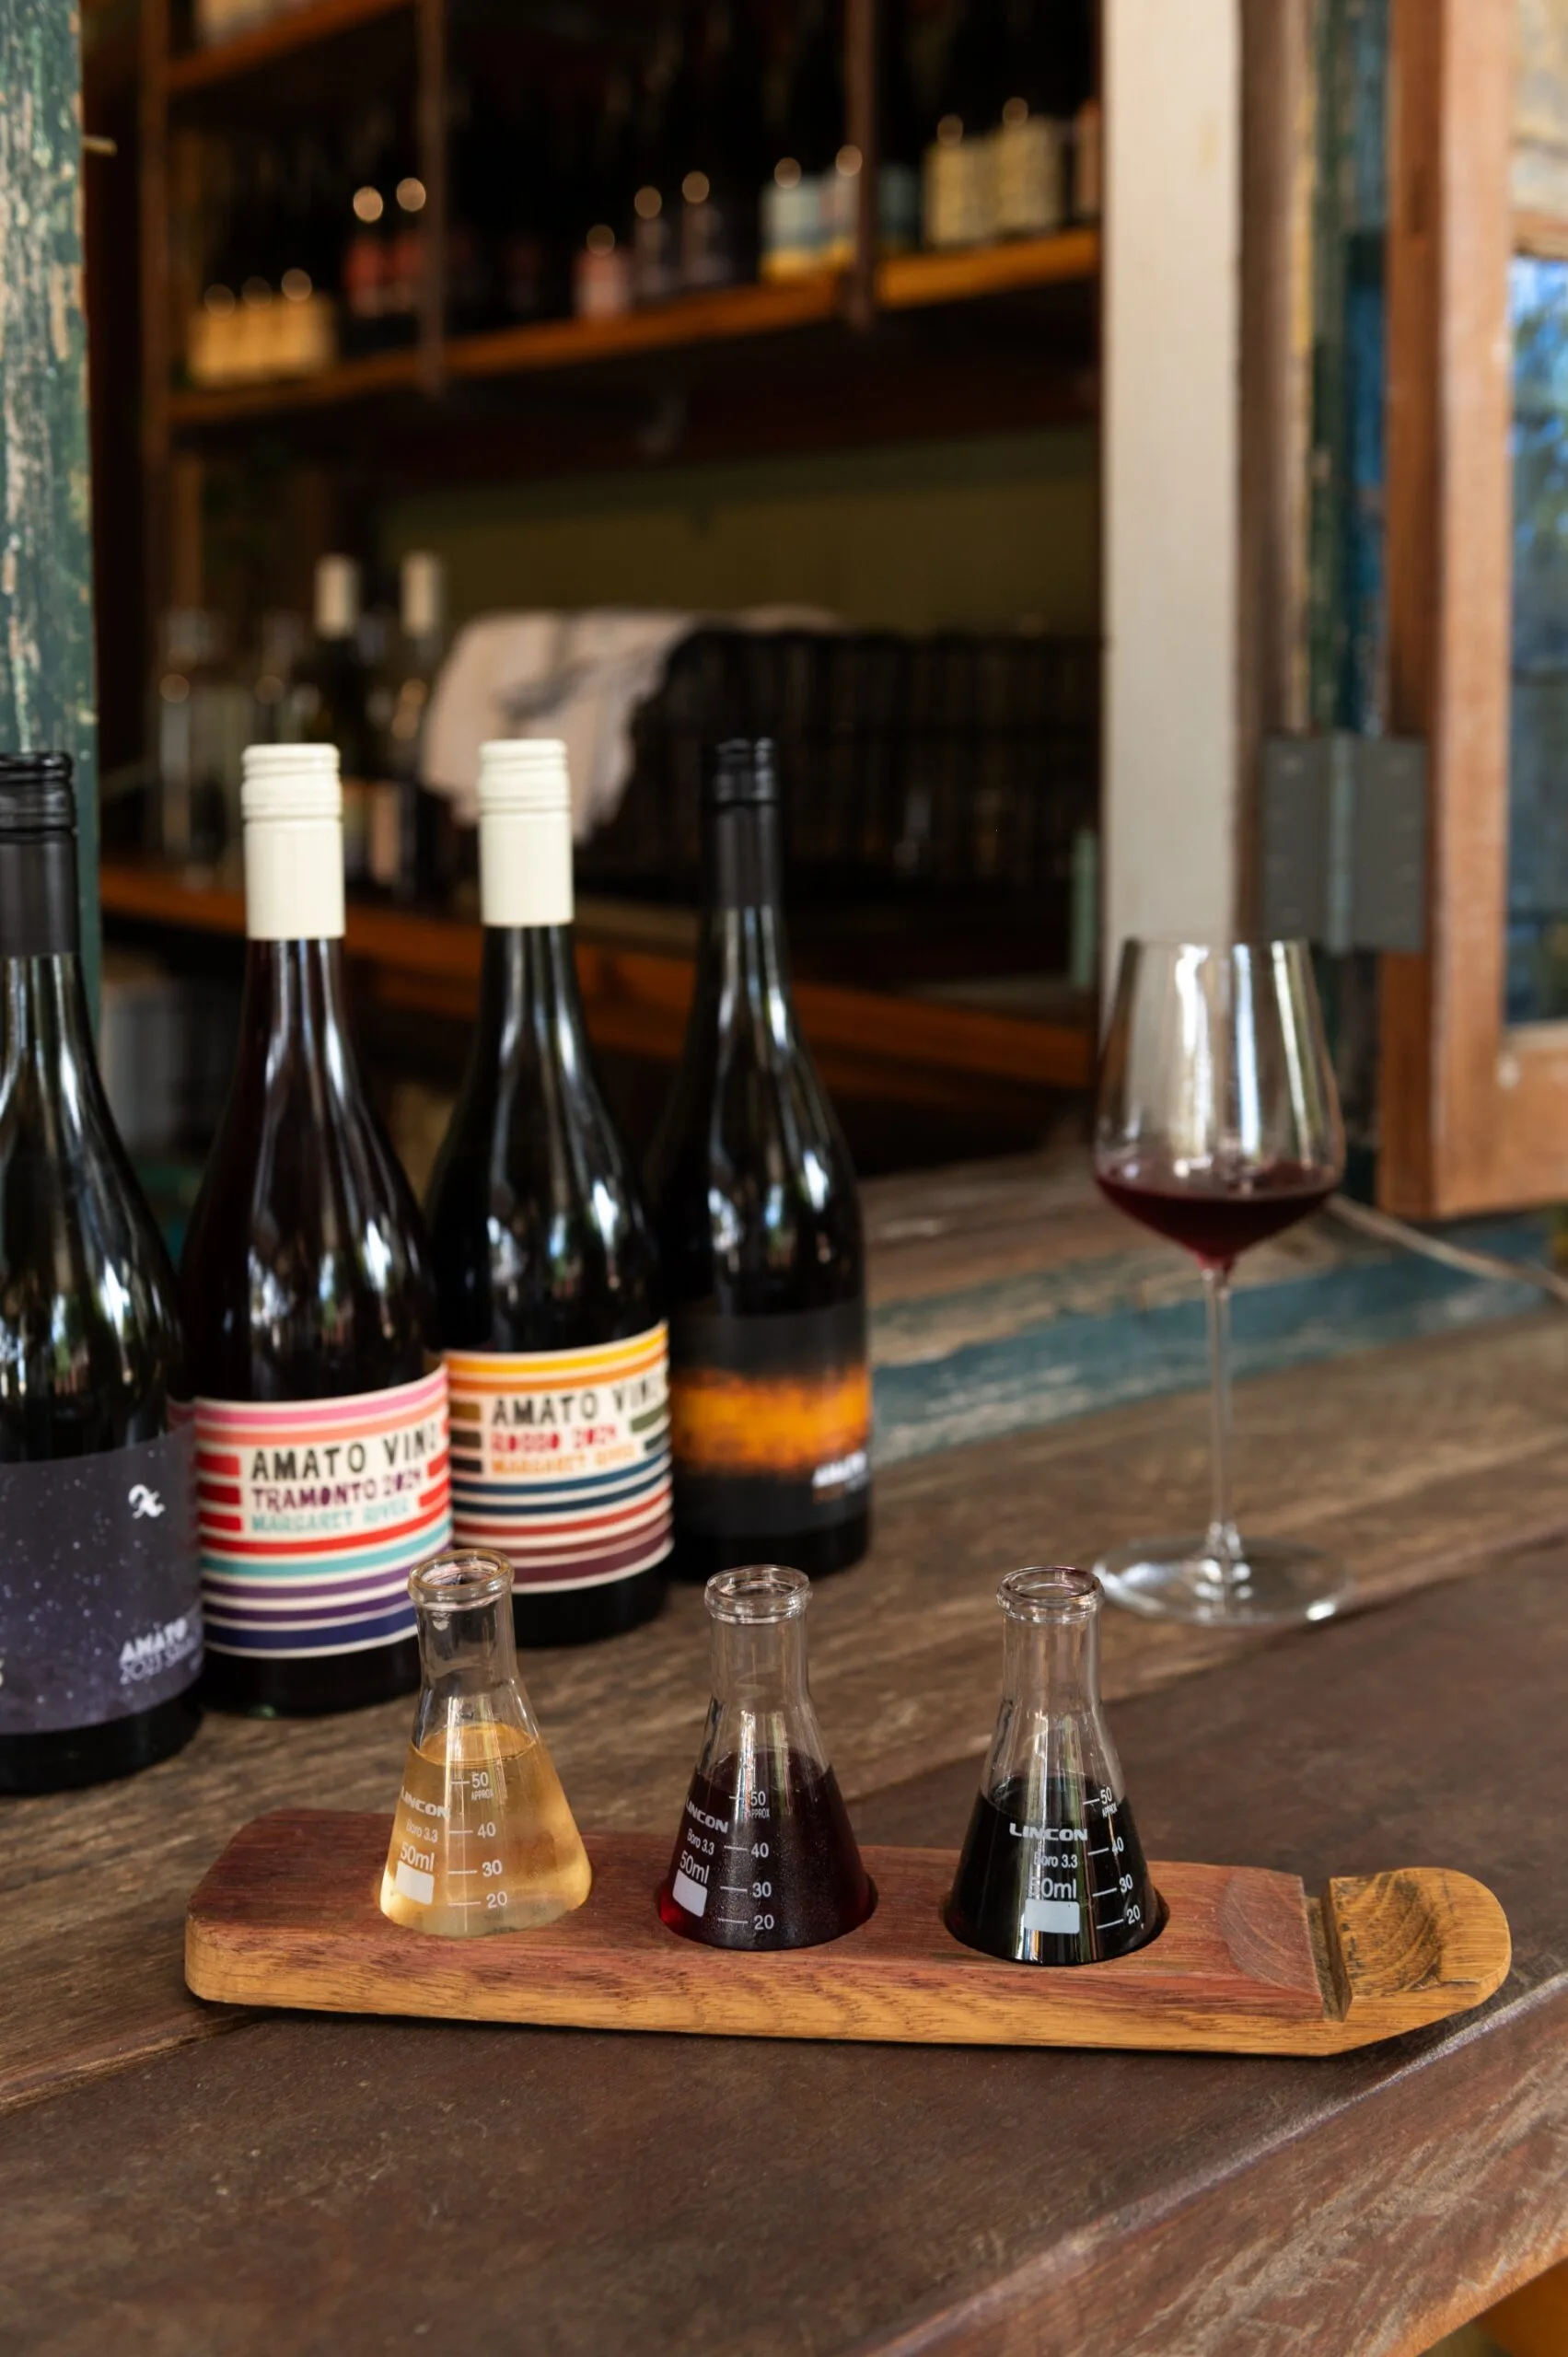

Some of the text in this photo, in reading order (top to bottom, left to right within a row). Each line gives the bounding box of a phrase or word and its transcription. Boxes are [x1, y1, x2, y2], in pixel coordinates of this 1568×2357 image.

[492, 1390, 598, 1427] AMATO
[251, 1441, 366, 1481] AMATO
[251, 1477, 378, 1514] TRAMONTO
[471, 1771, 489, 1789] 50
[401, 1785, 451, 1820] LINCON
[750, 1791, 766, 1807] 50
[1100, 1786, 1112, 1805] 50
[685, 1797, 729, 1834] LINCON
[423, 1827, 438, 1844] 3.3
[477, 1821, 496, 1839] 40
[1009, 1822, 1088, 1841] LINCON
[687, 1828, 715, 1856] Boro 3.3
[750, 1842, 770, 1859] 40
[1111, 1837, 1124, 1857] 40
[400, 1841, 436, 1873] 50ml
[1033, 1851, 1078, 1869] Boro 3.3
[482, 1859, 503, 1877] 30
[679, 1851, 710, 1884] 50ml
[752, 1882, 772, 1898] 30
[1119, 1874, 1133, 1894] 30
[486, 1891, 508, 1910] 20
[753, 1914, 774, 1931] 20
[1126, 1905, 1142, 1925] 20
